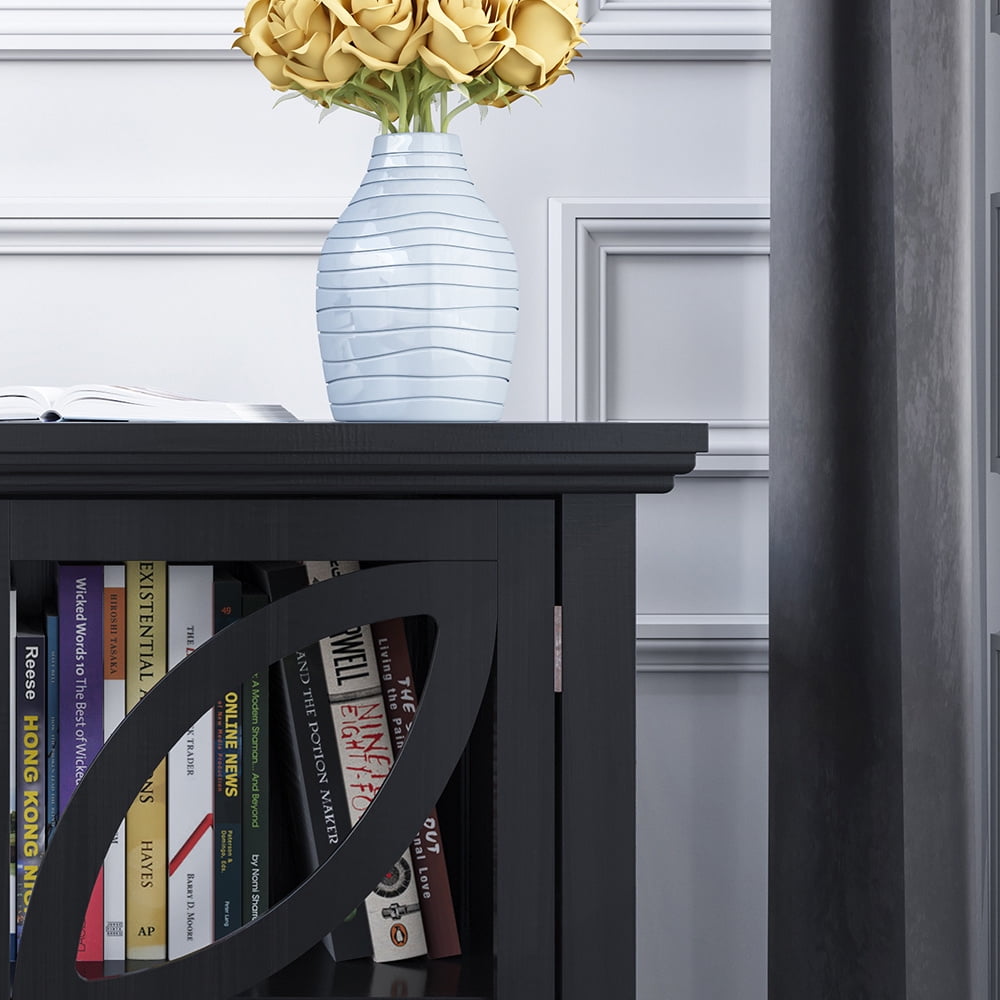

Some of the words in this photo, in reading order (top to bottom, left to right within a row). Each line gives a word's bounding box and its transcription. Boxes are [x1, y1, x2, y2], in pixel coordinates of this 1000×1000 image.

[75, 578, 87, 621] Wicked
[110, 594, 118, 634] HIROSHI
[139, 561, 154, 681] EXISTENTIAL
[186, 625, 195, 645] THE
[75, 624, 87, 661] Words
[110, 638, 118, 675] TASAKA
[25, 646, 39, 700] Reese
[75, 663, 85, 676] 10
[252, 680, 259, 688] A
[296, 651, 310, 684] AND
[378, 638, 392, 681] Living
[387, 688, 397, 710] the
[75, 679, 87, 700] The
[303, 688, 317, 717] THE
[398, 676, 416, 713] THE
[75, 702, 87, 728] Best
[225, 692, 238, 749] ONLINE
[23, 715, 39, 783] HONG
[75, 729, 87, 742] of
[308, 721, 328, 784] POTION
[186, 739, 195, 776] TRADER
[225, 753, 238, 798] NEWS
[23, 791, 39, 857] KONG
[250, 793, 259, 828] Beyond
[320, 789, 339, 845] MAKER
[140, 841, 153, 888] HAYES
[250, 854, 260, 866] by
[251, 868, 260, 892] Nomi
[418, 867, 430, 899] Love
[138, 926, 155, 937] AP
